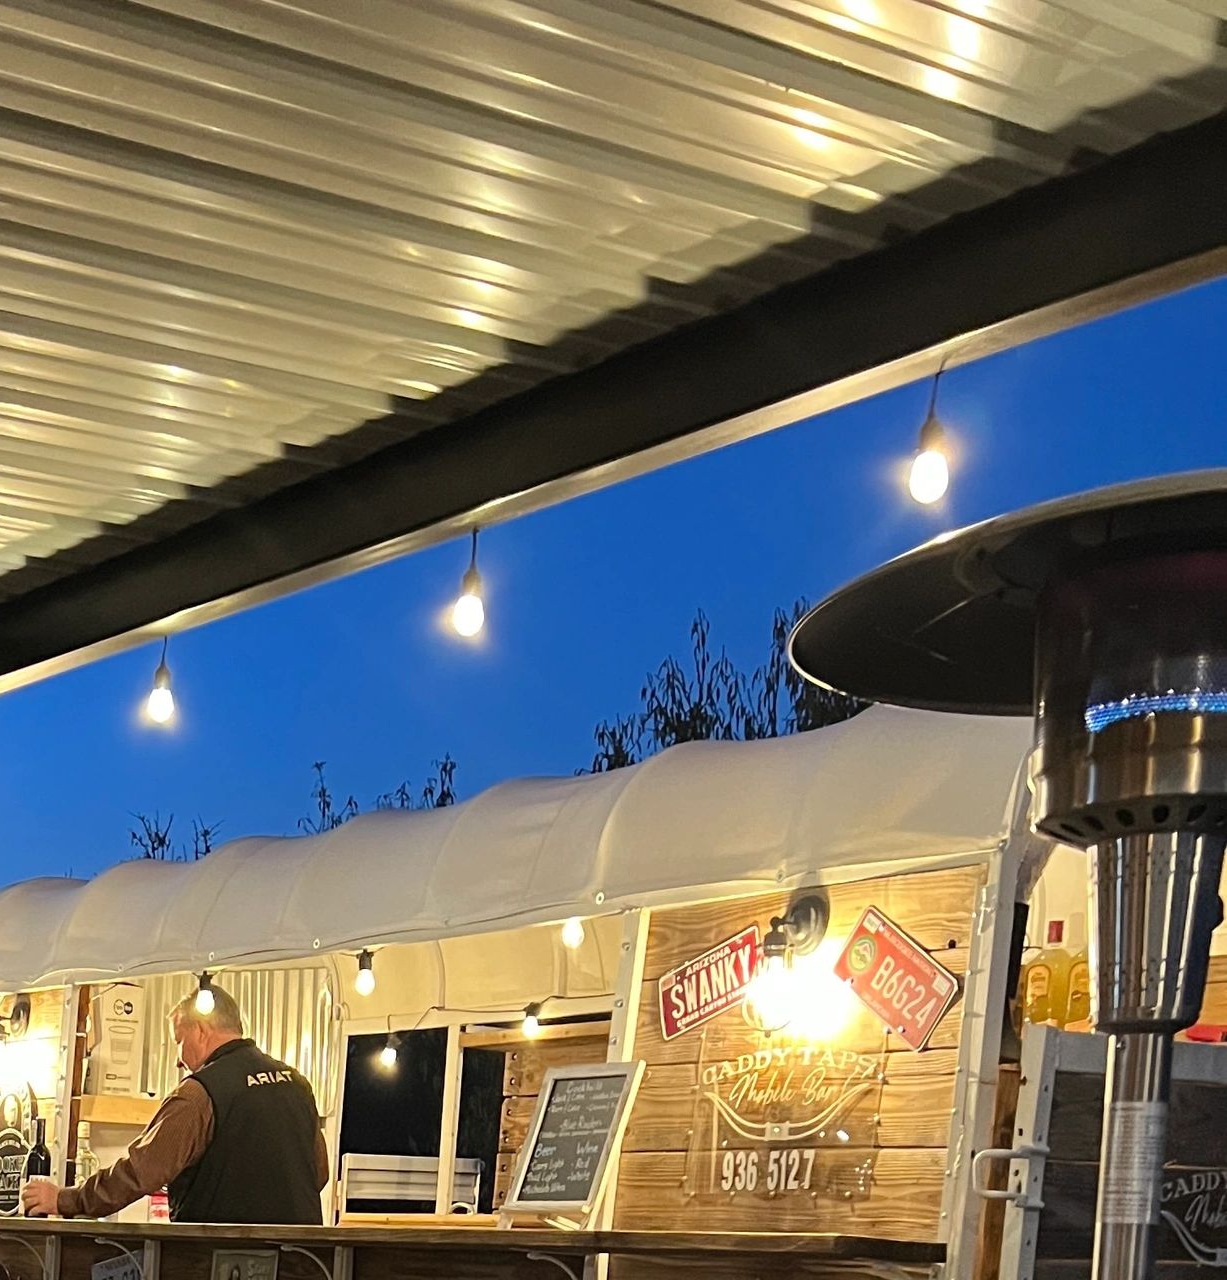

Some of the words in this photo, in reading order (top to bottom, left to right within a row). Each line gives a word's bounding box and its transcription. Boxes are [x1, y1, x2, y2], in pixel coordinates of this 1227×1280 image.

[686, 946, 732, 977] ARIZONA
[670, 944, 751, 1019] SWANKY
[247, 1070, 292, 1087] ARIAT
[702, 1047, 791, 1086] CADDY
[796, 1046, 876, 1070] TAPS
[729, 1069, 796, 1109] Mobile
[802, 1067, 836, 1106] Bar
[534, 1143, 557, 1158] Beer
[576, 1141, 599, 1154] Wine
[721, 1151, 759, 1191] 936
[767, 1149, 815, 1191] 5127
